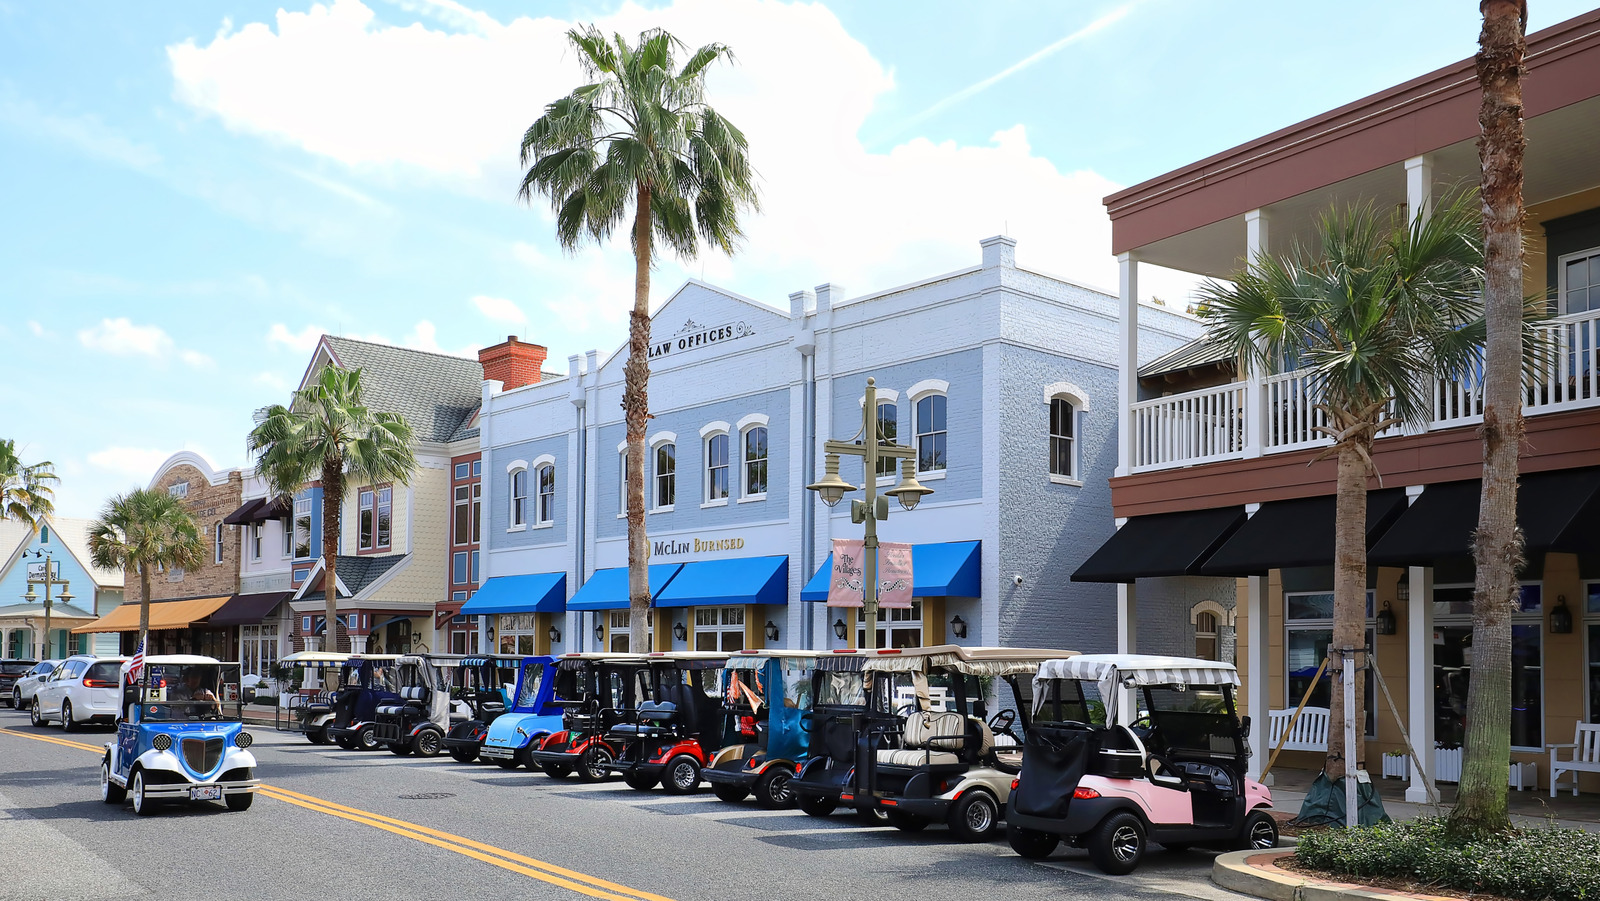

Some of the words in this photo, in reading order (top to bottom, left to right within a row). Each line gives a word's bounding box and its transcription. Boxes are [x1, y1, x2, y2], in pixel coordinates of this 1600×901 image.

[648, 342, 672, 358] LAW
[678, 325, 733, 350] OFFICES
[840, 553, 854, 565] The
[834, 562, 862, 577] Villages
